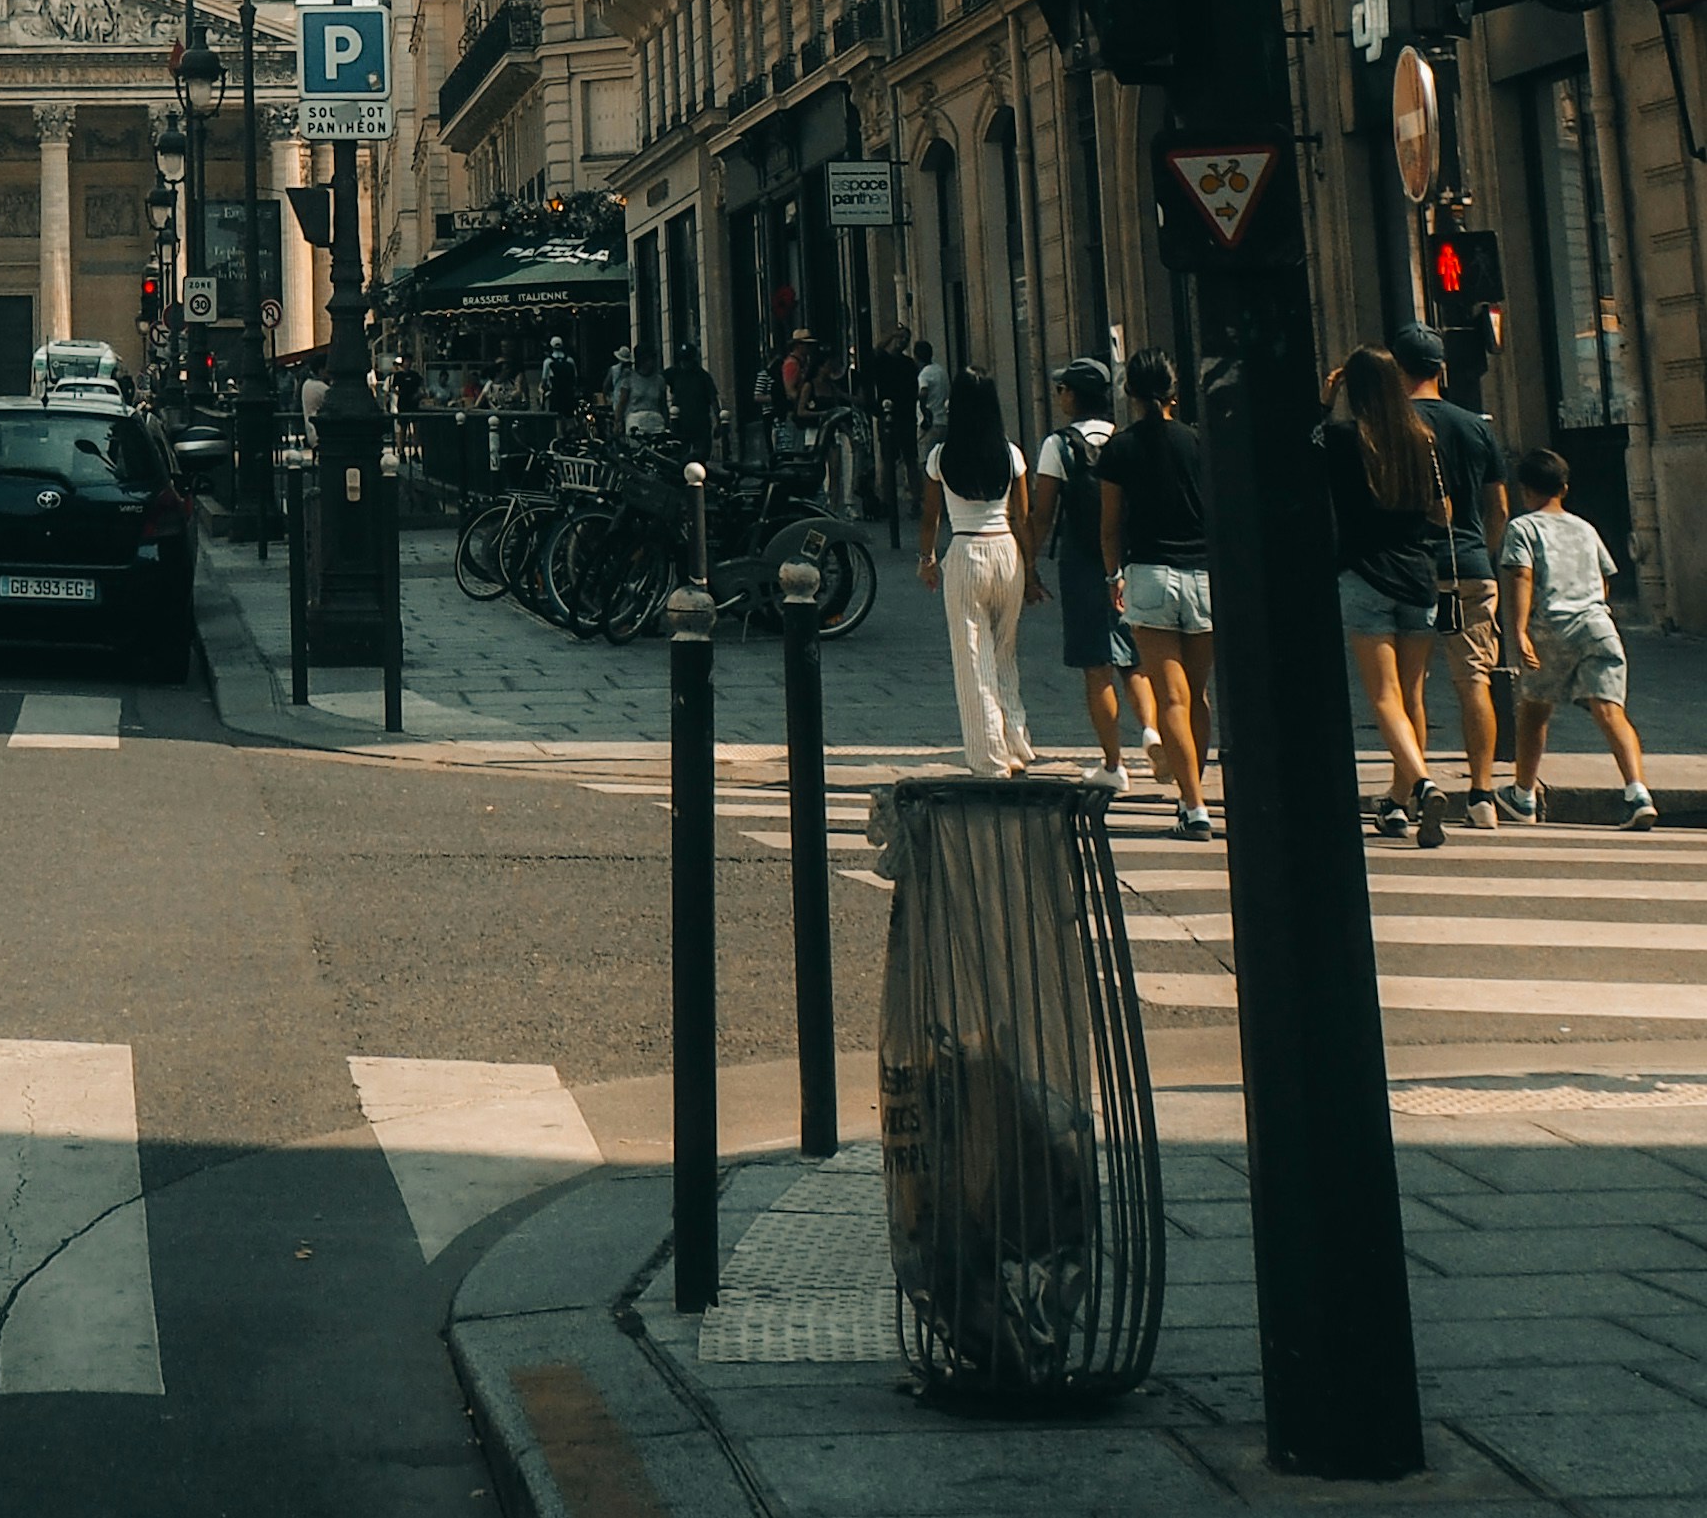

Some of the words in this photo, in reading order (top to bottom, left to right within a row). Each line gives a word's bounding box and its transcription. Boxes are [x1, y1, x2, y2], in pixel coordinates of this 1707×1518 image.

[323, 24, 363, 80] P
[308, 106, 384, 119] SOULOT
[189, 281, 211, 289] ZONE
[194, 300, 207, 310] 30
[462, 294, 510, 306] BRASSERIE
[518, 291, 569, 302] ITALIENNE
[10, 578, 84, 597] GB-393-EG
